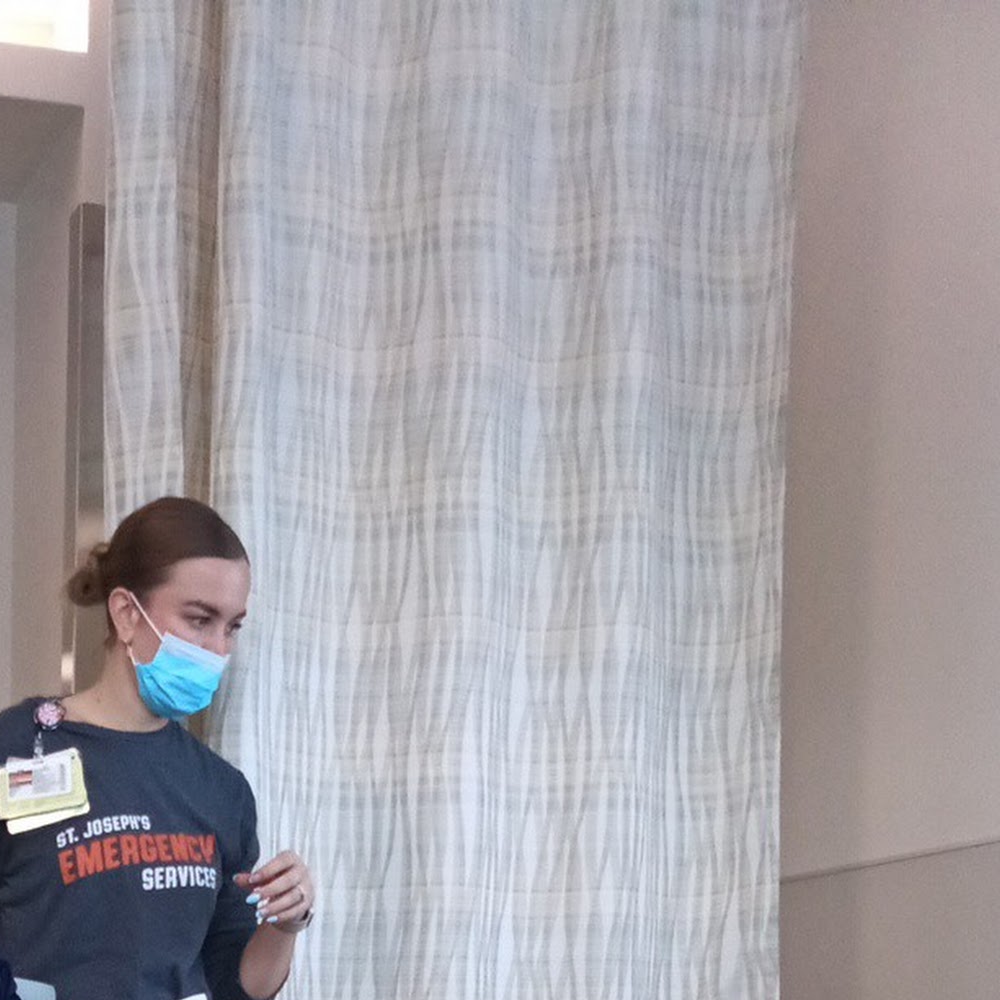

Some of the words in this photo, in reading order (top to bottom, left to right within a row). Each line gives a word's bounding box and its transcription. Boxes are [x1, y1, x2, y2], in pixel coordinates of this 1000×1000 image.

[56, 827, 79, 848] ST.
[83, 814, 151, 839] JOSEPH'S
[58, 832, 216, 886] EMERGENCY
[141, 865, 217, 891] SERVICES
